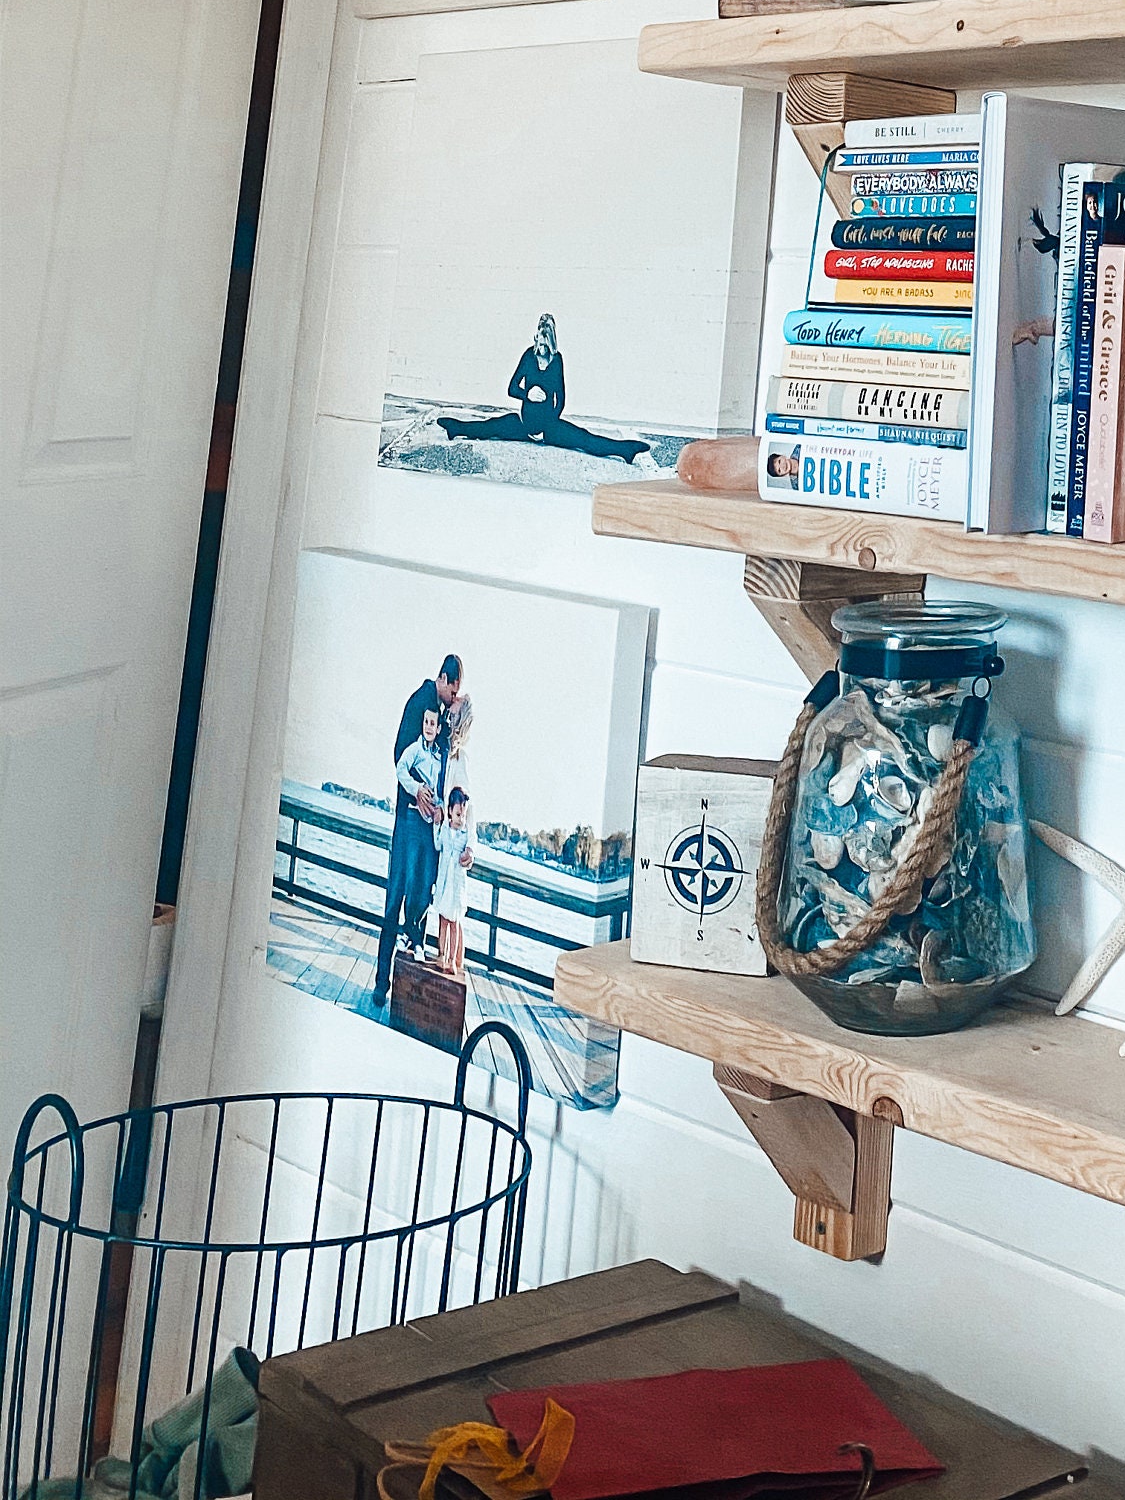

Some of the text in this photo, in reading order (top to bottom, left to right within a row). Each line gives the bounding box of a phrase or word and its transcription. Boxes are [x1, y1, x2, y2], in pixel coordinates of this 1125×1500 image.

[875, 126, 917, 137] BE STILL
[853, 153, 909, 164] LOVE LIVES HERE
[941, 152, 969, 162] MARIA
[929, 172, 978, 191] ALWAYS
[882, 196, 956, 213] LOVE DOES
[1063, 174, 1080, 255] MARIANNE
[860, 255, 882, 268] STOP
[883, 257, 934, 269] APOLOGIZING
[946, 258, 974, 271] RACHE
[862, 287, 934, 298] YOU ARE A BADASS
[1059, 258, 1076, 351] WILLIAMSON
[1078, 230, 1098, 395] Battlefield of the mind
[792, 319, 866, 344] TODD HENRY
[873, 323, 934, 347] HERDING
[1099, 264, 1117, 402] Grit & Grace
[790, 350, 957, 371] Balance Your Hormones, Balance Your Life
[858, 388, 943, 411] DANCING
[857, 405, 940, 423] ON MY GRAVE
[879, 427, 913, 440] SHAUNA
[1076, 409, 1087, 450] JOYCE
[805, 444, 874, 459] THE EVERYDAY LIFE
[1056, 434, 1069, 451] TO
[803, 457, 871, 499] BIBLE
[1053, 453, 1067, 487] LOVE
[1073, 454, 1086, 500] MEYER
[917, 457, 931, 508] JOYCE
[930, 456, 944, 511] MEYER
[701, 798, 709, 810] N
[640, 857, 650, 870] W
[697, 930, 704, 941] S
